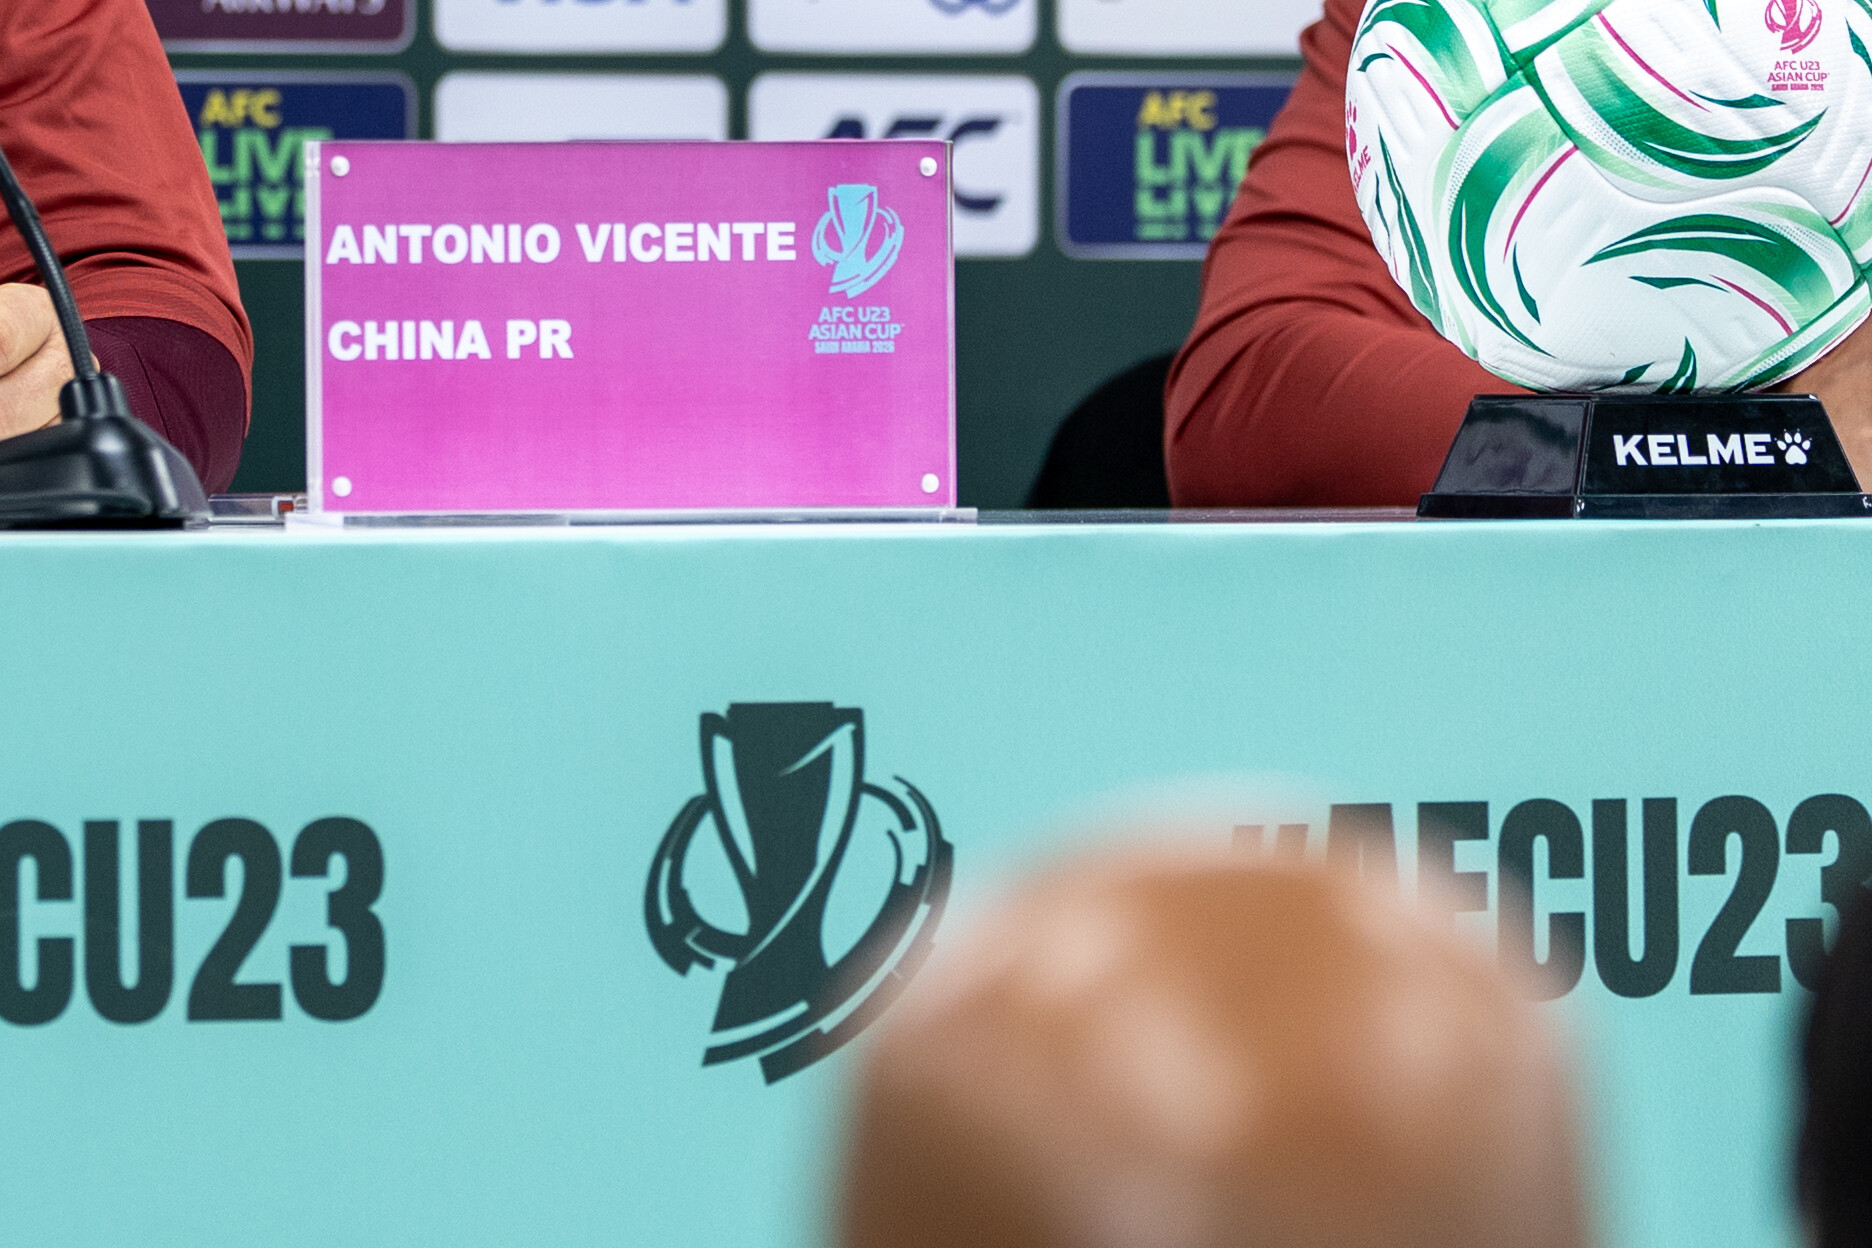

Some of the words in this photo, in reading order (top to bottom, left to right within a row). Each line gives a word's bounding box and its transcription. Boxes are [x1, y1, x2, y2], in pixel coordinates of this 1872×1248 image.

[1767, 72, 1803, 83] ASIAN
[1774, 61, 1798, 71] AFC
[1800, 60, 1820, 71] U23
[199, 88, 283, 129] AFC
[1139, 90, 1218, 132] AFC
[326, 223, 561, 264] ANTONIO
[575, 222, 797, 263] VICENTE
[818, 306, 854, 323] AFC
[857, 306, 891, 323] U23
[328, 320, 492, 361] CHINA
[506, 319, 574, 359] PR
[808, 323, 862, 340] ASIAN
[1613, 433, 1776, 466] KELME
